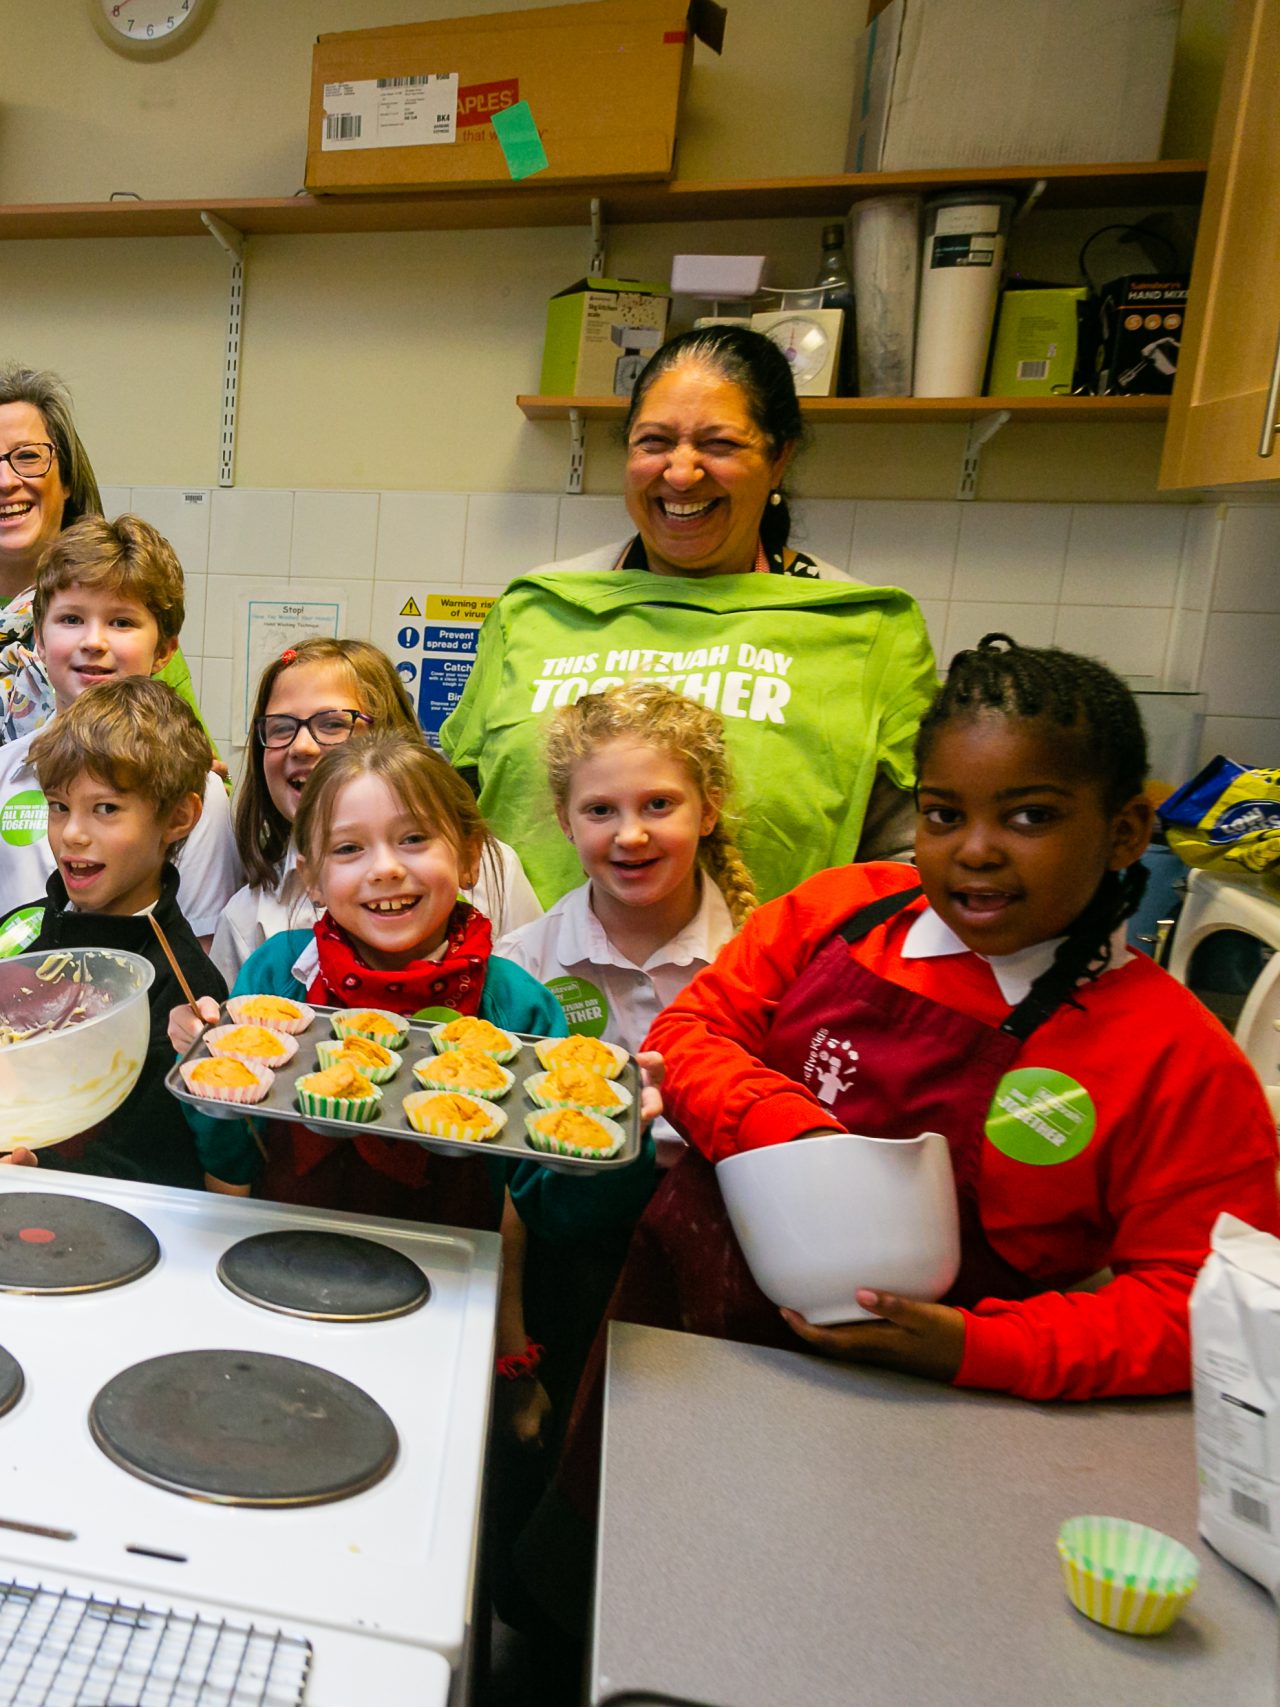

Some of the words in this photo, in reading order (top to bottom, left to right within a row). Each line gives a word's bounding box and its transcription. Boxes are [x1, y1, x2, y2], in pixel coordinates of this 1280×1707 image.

[127, 19, 135, 32] 7
[166, 16, 175, 29] 5
[146, 24, 155, 37] 6
[457, 90, 512, 115] APLES
[1128, 290, 1162, 300] HAND
[441, 598, 478, 610] Warning
[282, 605, 305, 616] Stop!
[450, 610, 461, 618] of
[464, 610, 486, 619] virus
[439, 629, 475, 640] Prevent
[426, 640, 459, 650] spread
[461, 641, 472, 650] of
[542, 653, 600, 677] THIS
[604, 644, 730, 673] MITZVAH
[737, 642, 794, 677] DAY
[443, 662, 473, 672] Catch
[2, 809, 17, 820] ALL
